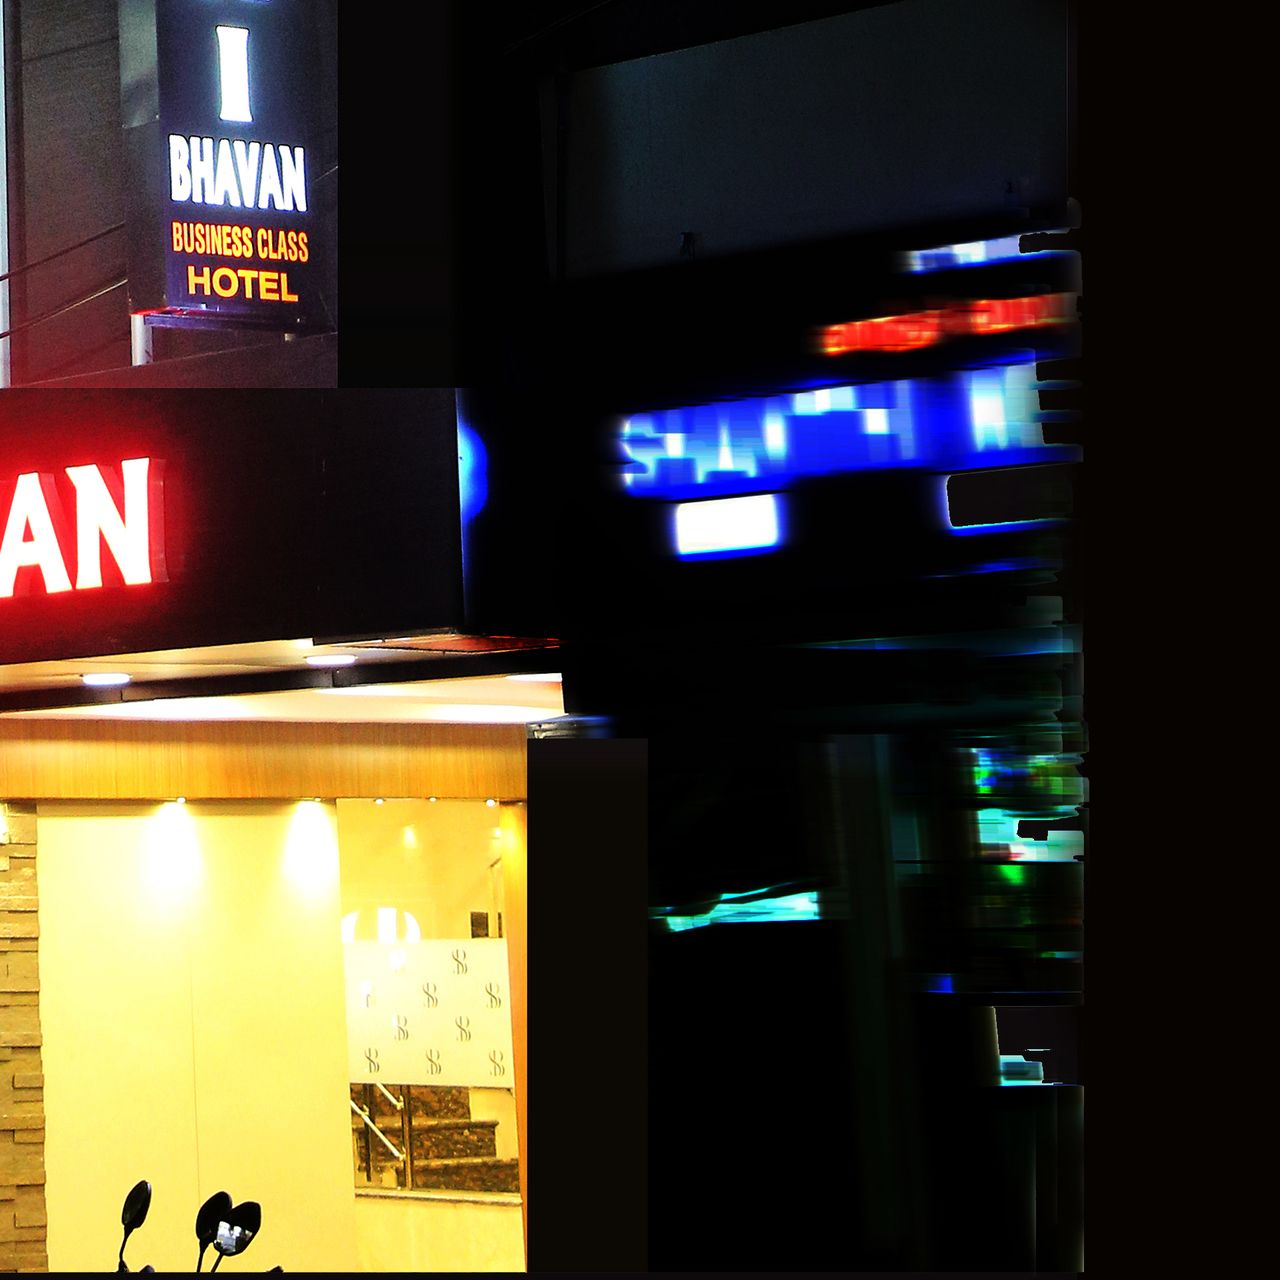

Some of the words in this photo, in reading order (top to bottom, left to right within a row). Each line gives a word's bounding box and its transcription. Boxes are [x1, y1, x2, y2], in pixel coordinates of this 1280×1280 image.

[169, 134, 308, 212] BHAVAN
[172, 221, 253, 258] BUSINESS
[256, 228, 309, 262] CLASS
[187, 265, 299, 302] HOTEL
